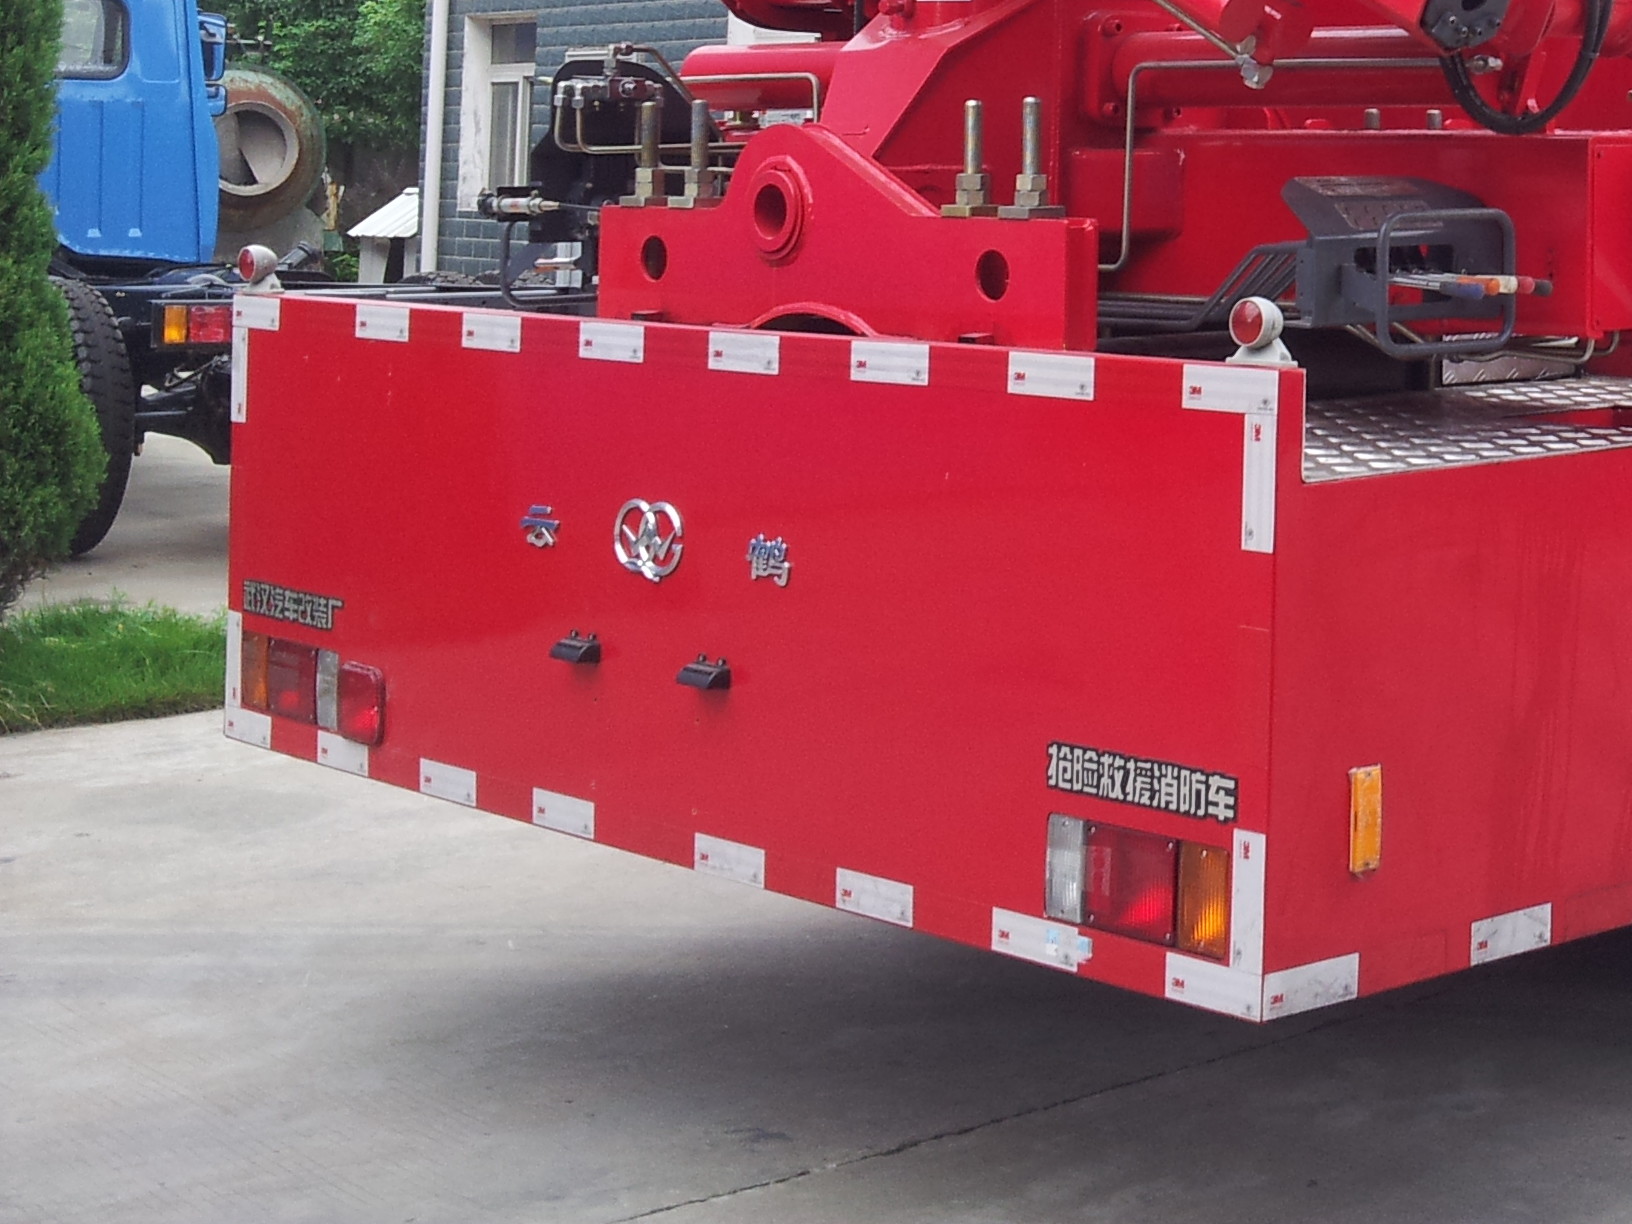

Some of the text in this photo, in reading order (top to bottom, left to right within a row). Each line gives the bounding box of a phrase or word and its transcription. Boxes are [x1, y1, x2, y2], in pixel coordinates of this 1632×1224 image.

[521, 504, 792, 587] 云 鹤
[243, 579, 344, 630] 武汉汽车改装厂
[1047, 742, 1238, 821] 抢险救援消防车
